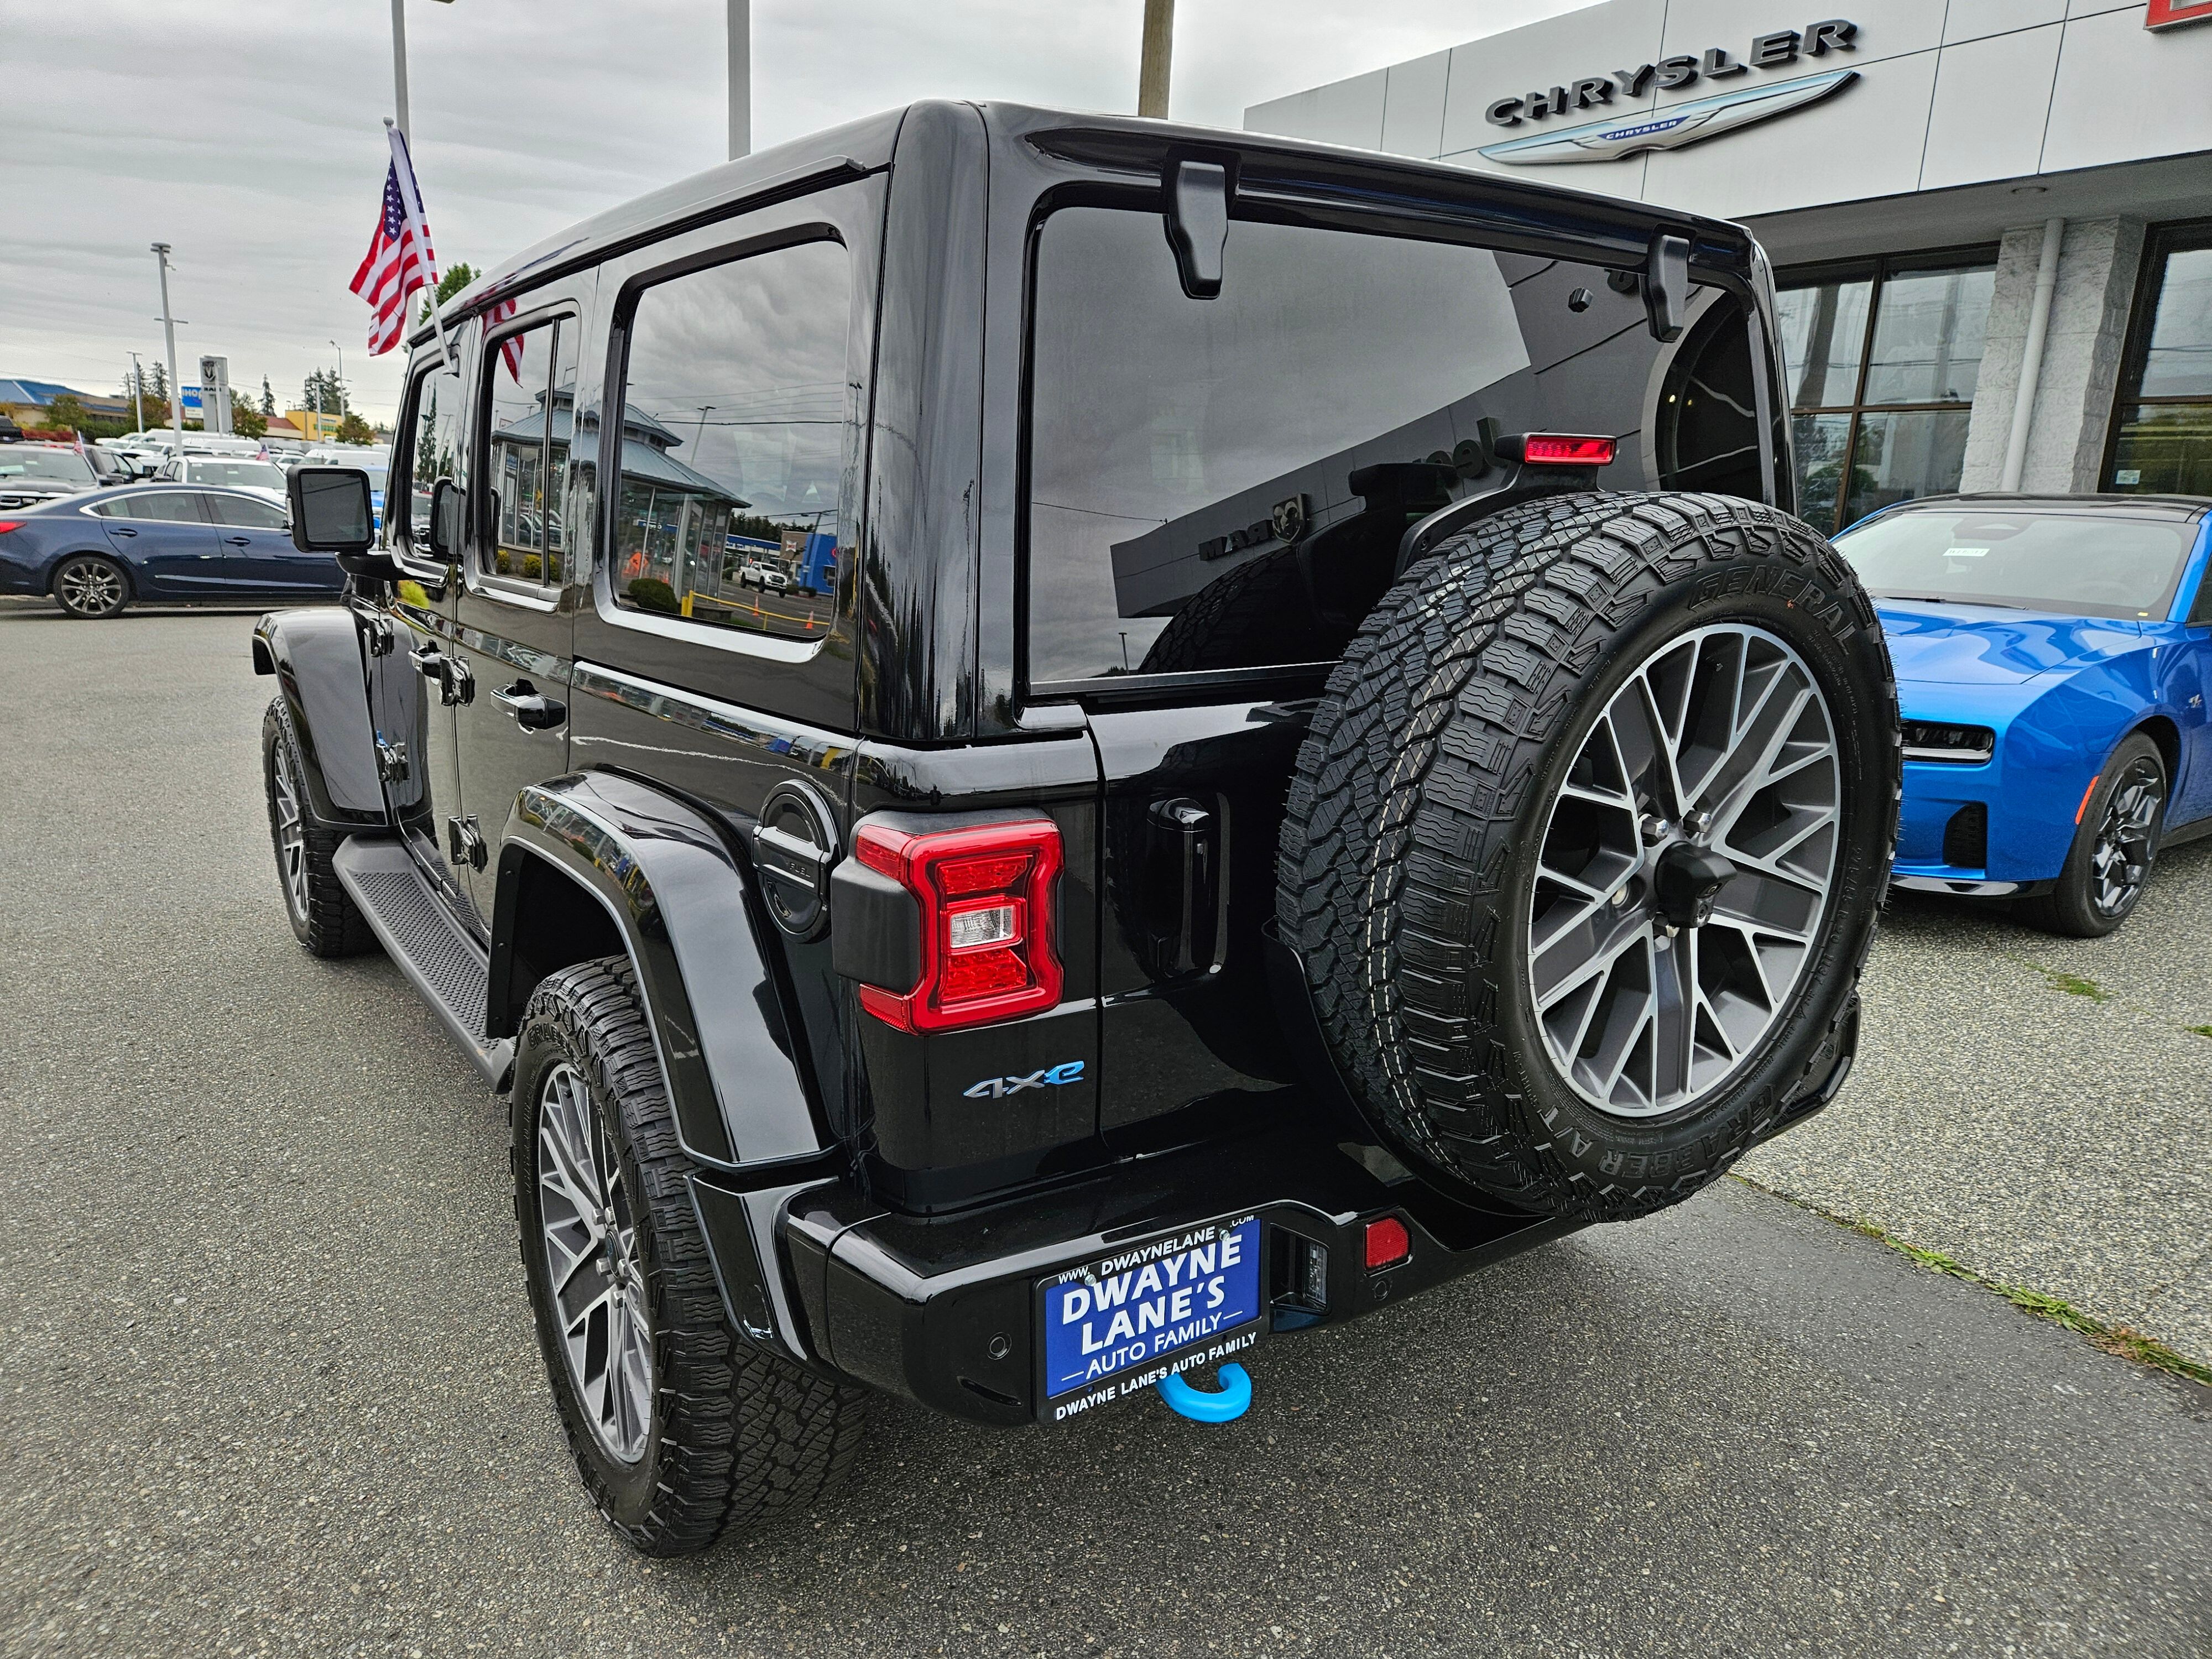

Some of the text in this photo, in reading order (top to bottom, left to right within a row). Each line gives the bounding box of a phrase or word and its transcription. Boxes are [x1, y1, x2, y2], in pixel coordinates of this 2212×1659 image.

[1485, 19, 1858, 127] CHRYSLER
[1606, 118, 1677, 140] CHRYSLER
[1689, 565, 1856, 656] GENERAL
[789, 862, 811, 878] FUEL
[963, 1060, 1085, 1099] 4xe
[1062, 1234, 1242, 1325] DWAYNE
[1101, 1225, 1215, 1276] DWAYNELANE
[1082, 1276, 1225, 1356] LANE'S
[1086, 1312, 1224, 1380] AUTO FAMILY
[1056, 1332, 1256, 1421] DWAYNE LANE'S AUTO FAMILY
